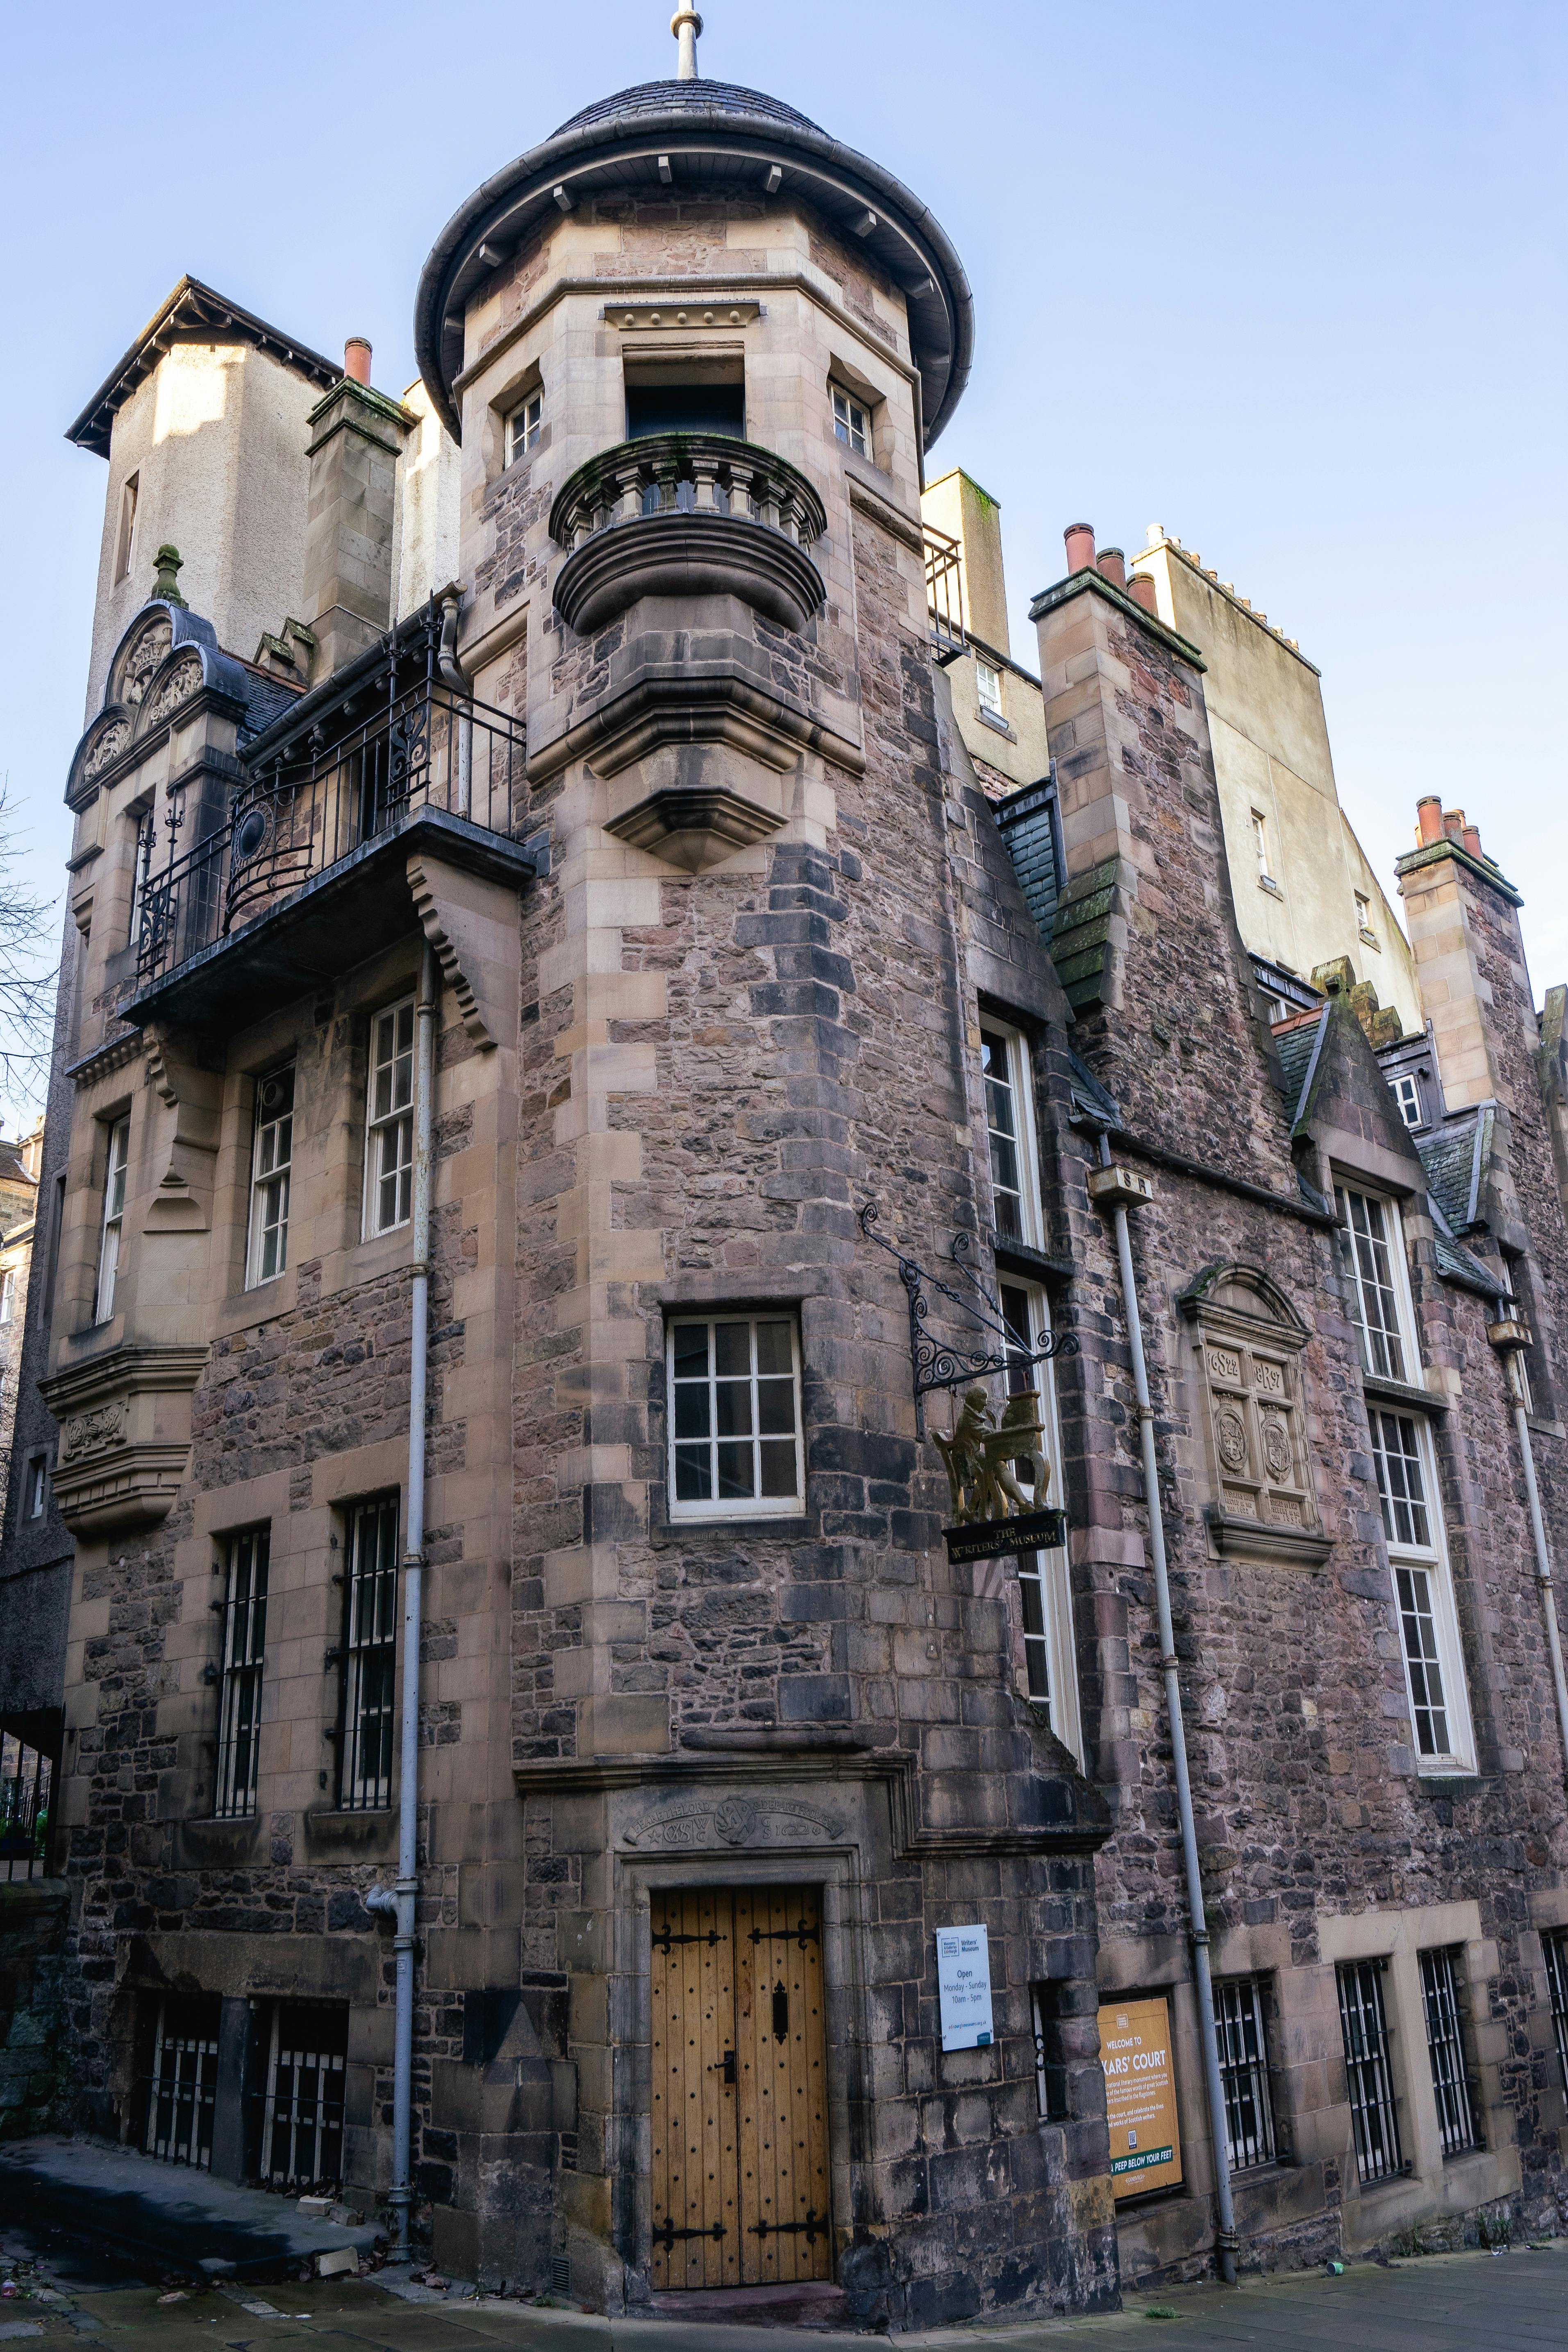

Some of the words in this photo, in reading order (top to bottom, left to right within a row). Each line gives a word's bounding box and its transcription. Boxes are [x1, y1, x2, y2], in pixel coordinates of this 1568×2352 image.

[1123, 1171, 1132, 1188] S
[1138, 1177, 1147, 1194] R
[1225, 1497, 1239, 1506] RECTED
[993, 1527, 1016, 1539] THE
[1009, 1530, 1056, 1547] MUSEUM
[682, 1802, 711, 1814] LORD
[775, 1825, 809, 1836] 1622
[957, 1970, 973, 1980] Open
[944, 1982, 964, 1993] Monday
[968, 1980, 986, 1990] Sunday
[952, 1995, 966, 2004] 10am
[970, 1993, 982, 2004] 5pm
[1107, 2037, 1133, 2050] WELCOME
[1134, 2036, 1142, 2045] TO
[1101, 2056, 1130, 2075] KARS'
[1133, 2050, 1166, 2070] COURT
[1114, 2095, 1129, 2103] inscribed
[1134, 2106, 1150, 2114] celebrate
[1128, 2115, 1143, 2124] Scottish
[1115, 2160, 1127, 2172] PEEP
[1128, 2156, 1145, 2168] BELOW
[1146, 2152, 1160, 2164] YOUR
[1161, 2150, 1172, 2161] FEET
